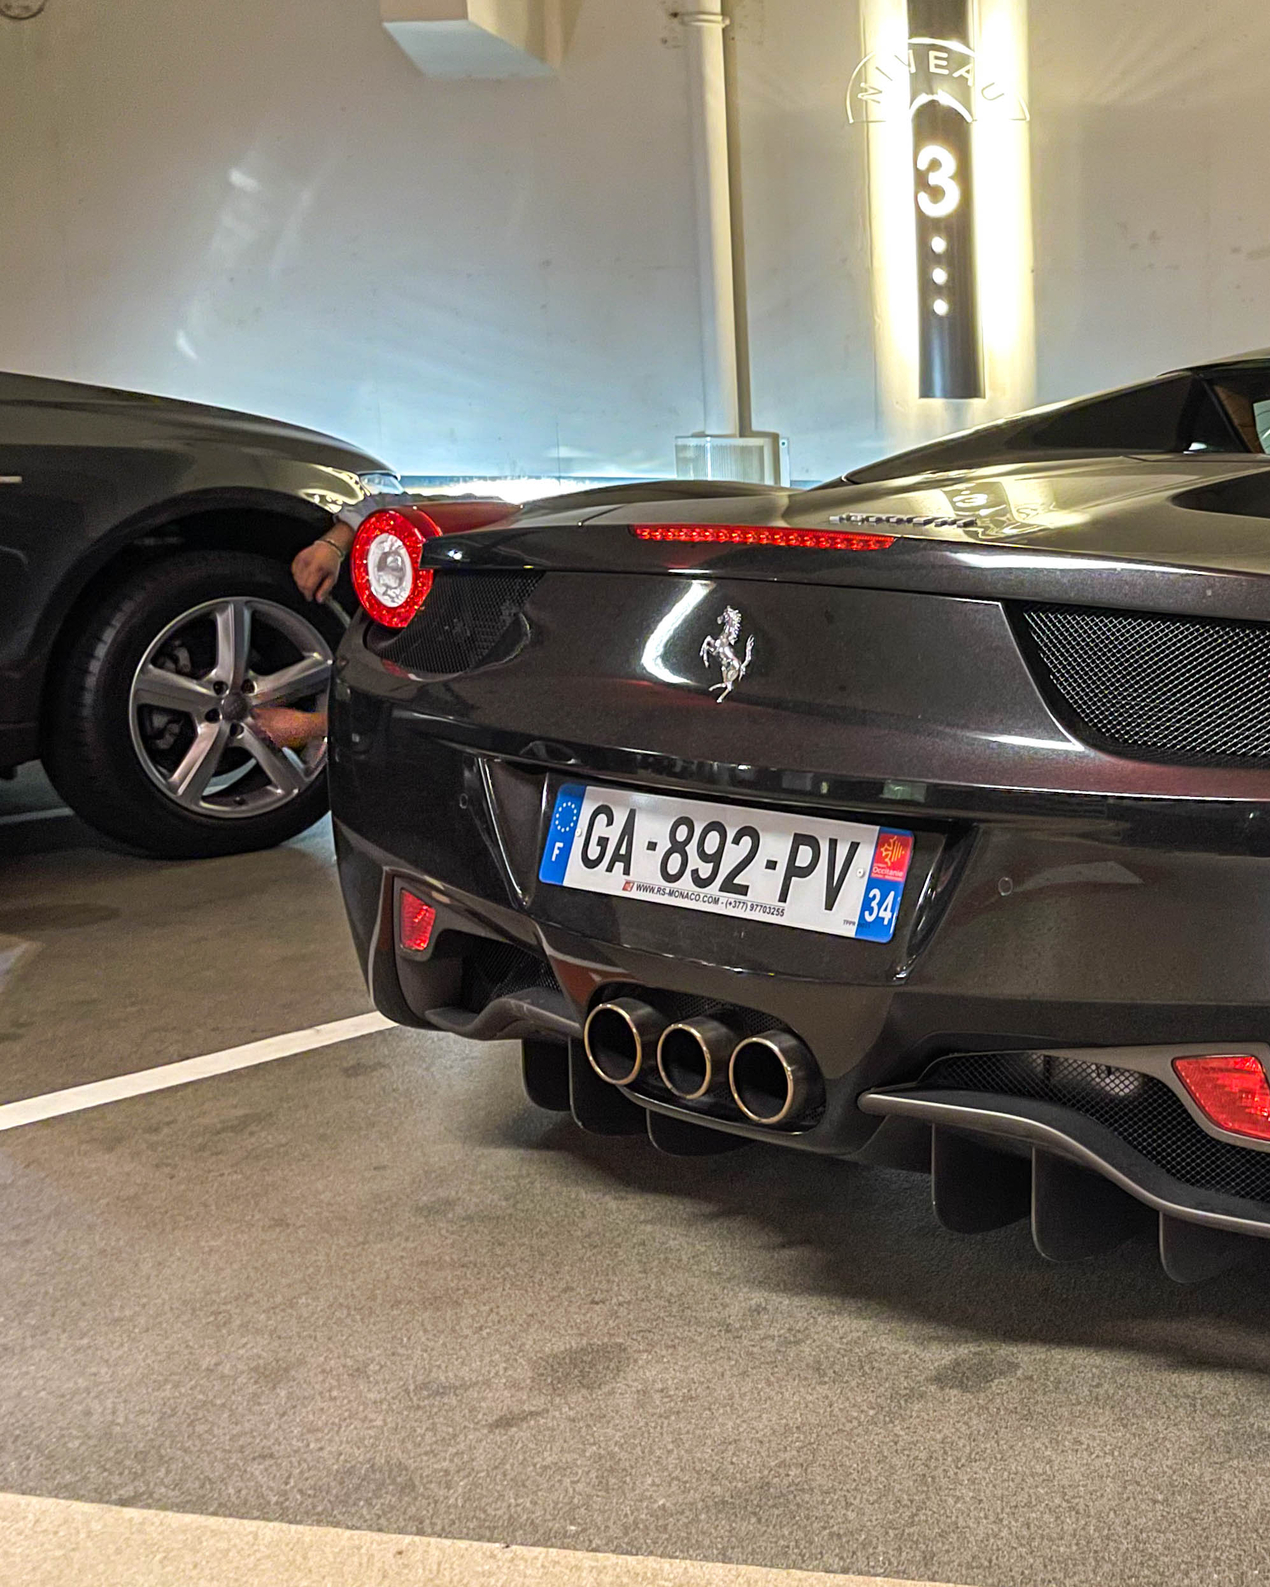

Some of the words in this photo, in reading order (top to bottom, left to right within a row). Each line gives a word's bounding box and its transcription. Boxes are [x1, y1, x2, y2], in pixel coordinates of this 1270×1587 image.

[857, 49, 1005, 104] NIVEAU
[916, 144, 961, 218] 3
[551, 841, 563, 862] F
[580, 804, 861, 911] GA-892-PV
[636, 882, 720, 905] WWW.RS-MONACO.COM
[725, 900, 748, 913] (+377)
[749, 903, 785, 917] 97703255
[864, 888, 895, 926] 34
